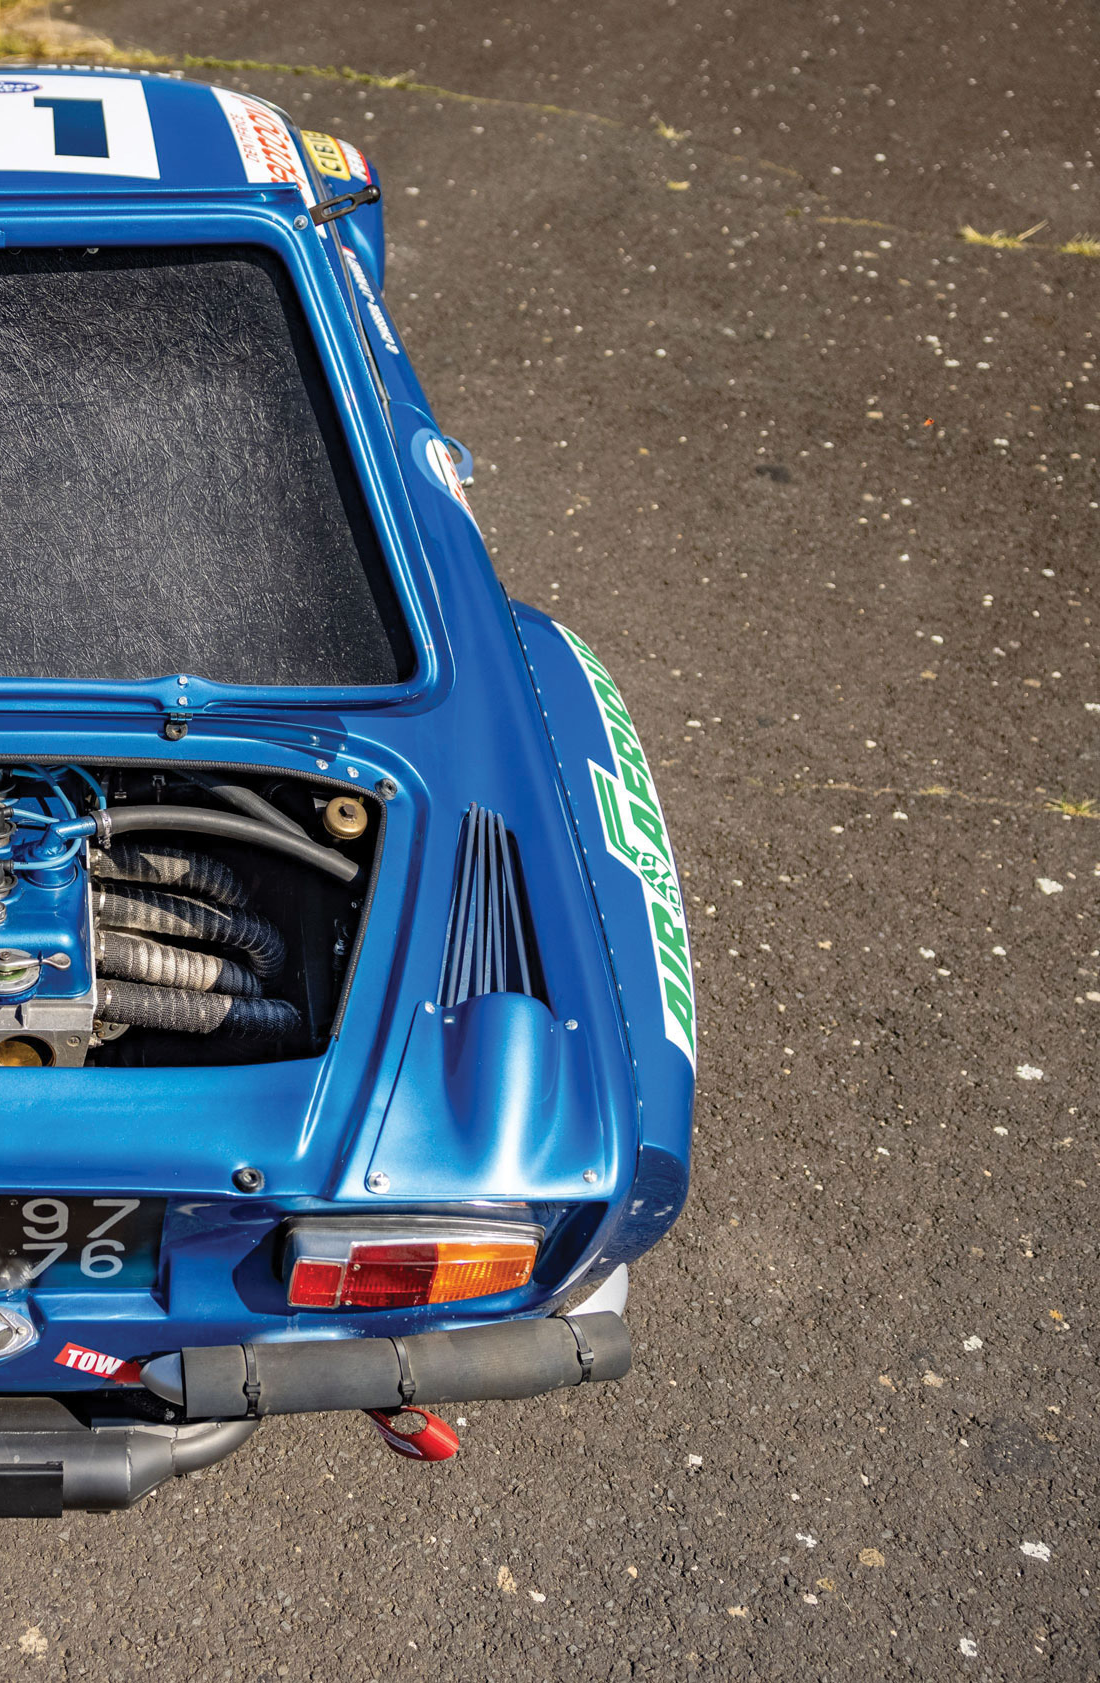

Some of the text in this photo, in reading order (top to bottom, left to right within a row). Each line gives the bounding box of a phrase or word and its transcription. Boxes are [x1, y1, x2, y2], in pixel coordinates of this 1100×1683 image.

[562, 627, 696, 1060] AIR AFRIQUE
[65, 1349, 126, 1376] TOW
